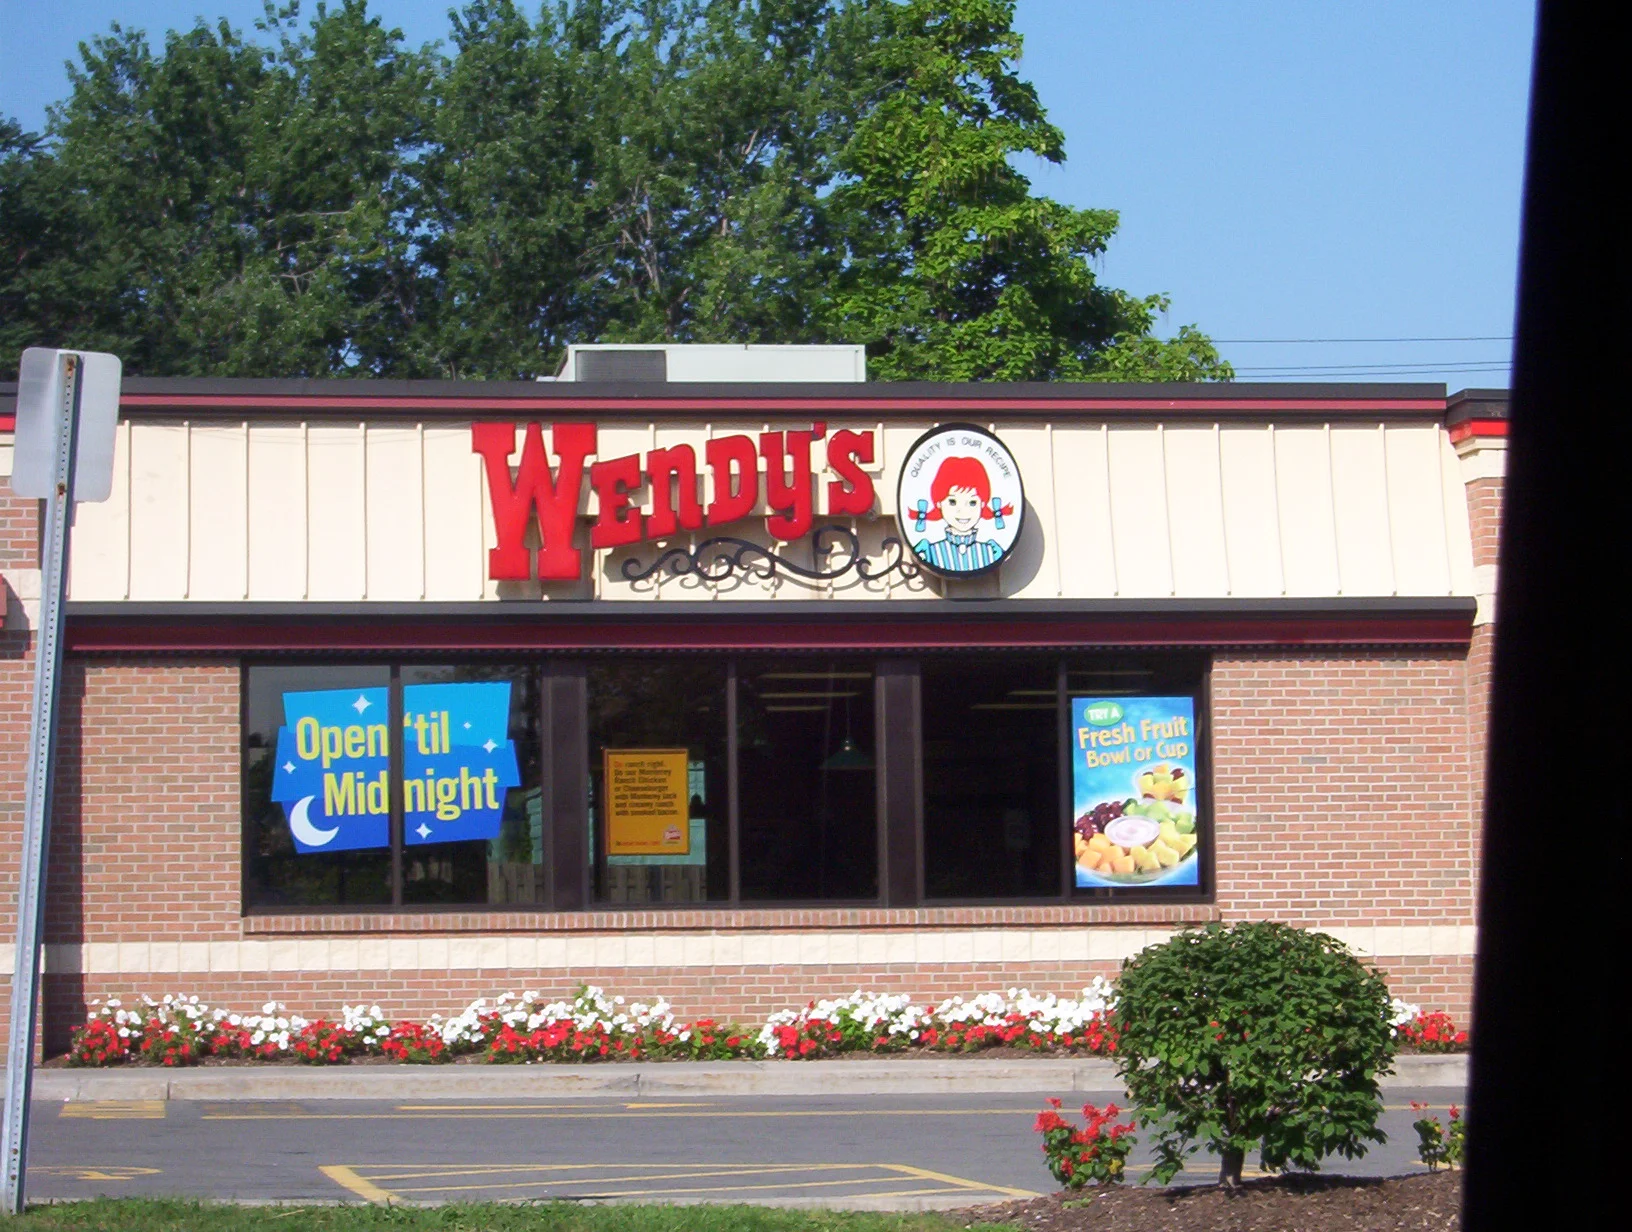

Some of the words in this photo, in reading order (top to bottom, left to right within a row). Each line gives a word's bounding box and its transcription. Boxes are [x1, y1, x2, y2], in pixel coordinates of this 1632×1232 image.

[910, 442, 941, 478] QUALITY
[946, 437, 956, 446] IS
[961, 436, 982, 449] OUR
[985, 446, 1012, 478] RECIPE
[1088, 708, 1109, 720] TRY
[1110, 706, 1120, 718] A
[296, 716, 388, 768] Open
[403, 711, 450, 755] 'til
[1078, 722, 1136, 749] Fresh
[1140, 716, 1188, 742] Fruit
[1086, 746, 1131, 768] Bowl
[1133, 746, 1153, 762] or
[1155, 741, 1189, 759] Cup
